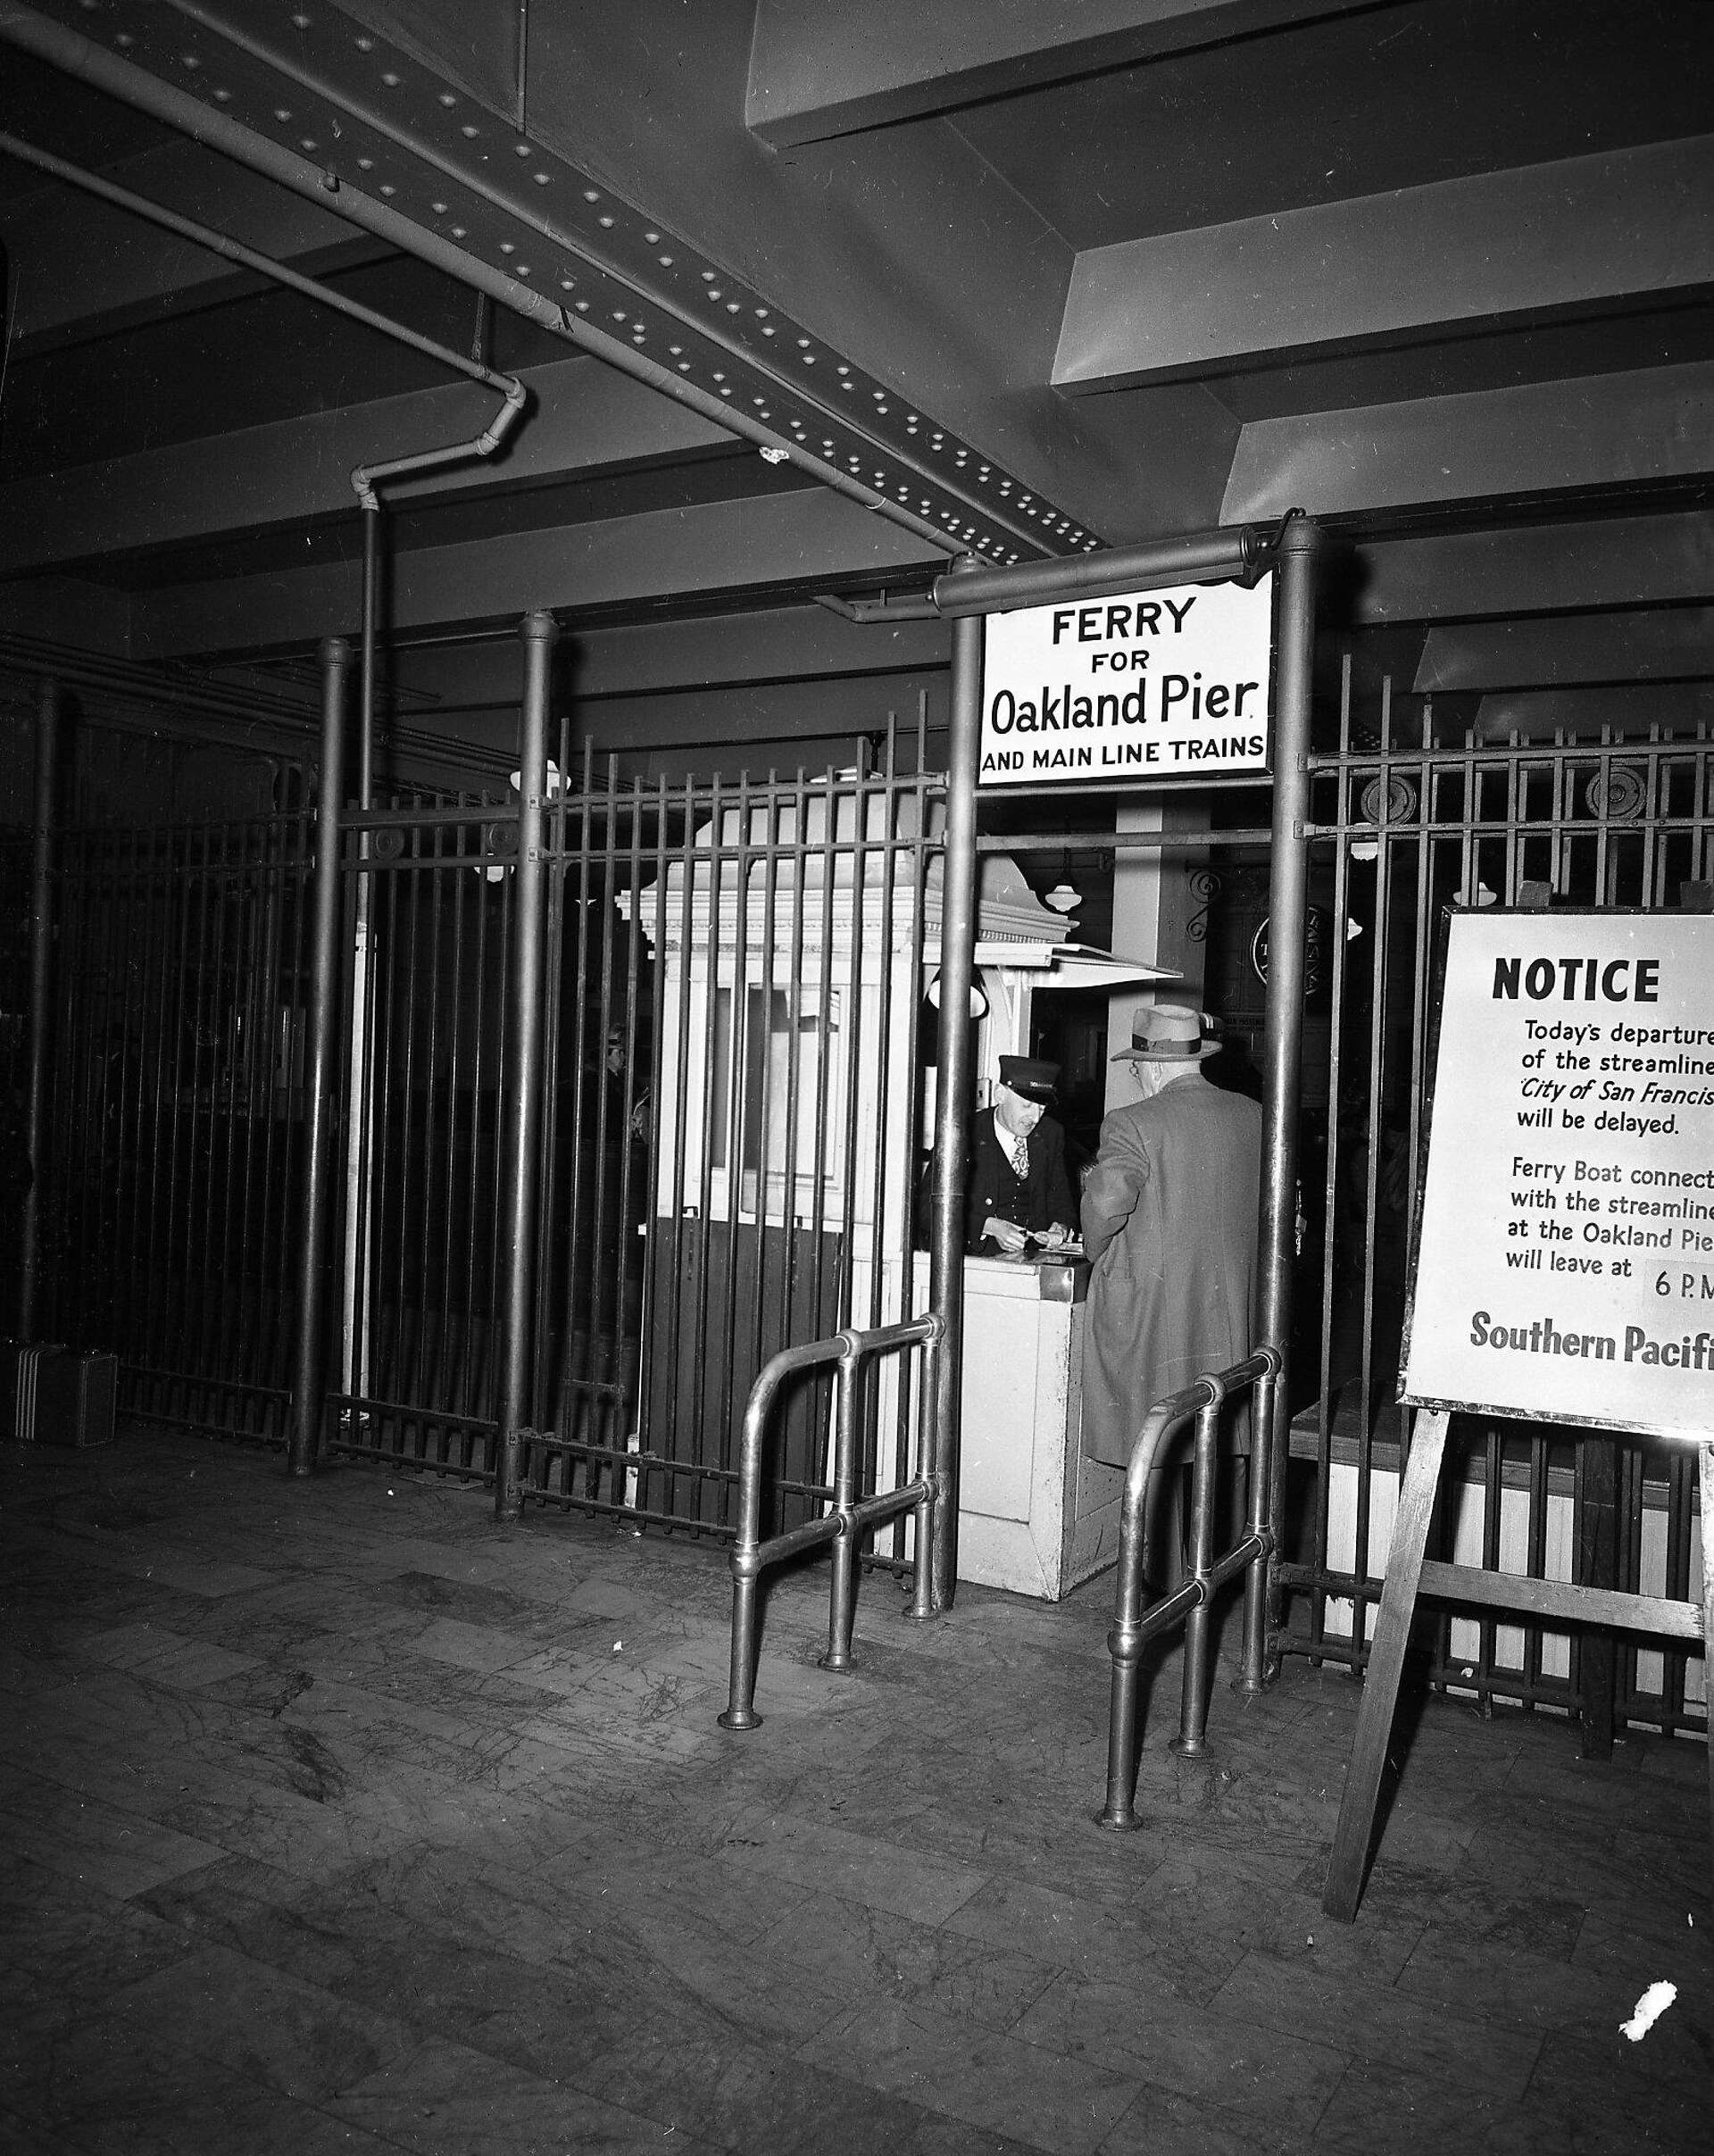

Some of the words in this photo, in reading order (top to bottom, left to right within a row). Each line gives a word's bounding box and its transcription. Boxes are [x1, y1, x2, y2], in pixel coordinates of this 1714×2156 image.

[1053, 596, 1197, 645] FERRY
[1092, 650, 1150, 673] FOR
[991, 678, 1146, 734] Oakland
[1161, 671, 1259, 722] Pier
[982, 752, 1024, 771] AND
[1033, 747, 1092, 768] MAIN
[1102, 743, 1160, 765] LINE
[1168, 736, 1264, 760] TRAINS
[1493, 958, 1660, 1002] NOTICE
[1525, 1020, 1601, 1045] Today's
[1610, 1022, 1714, 1046] departure
[1522, 1048, 1546, 1069] of
[1555, 1050, 1591, 1070] the
[1569, 1078, 1596, 1099] of
[1598, 1080, 1635, 1102] San
[1640, 1082, 1714, 1105] Francis
[1518, 1108, 1552, 1128] will
[1562, 1109, 1585, 1128] be
[1594, 1111, 1679, 1137] delayed.
[1513, 1156, 1566, 1184] Ferry
[1575, 1161, 1622, 1183] Boat
[1630, 1170, 1714, 1189] connect
[1511, 1188, 1557, 1209] with
[1566, 1191, 1600, 1211] the
[1508, 1220, 1528, 1237] at
[1539, 1220, 1573, 1240] the
[1583, 1222, 1672, 1248] Oakland
[1682, 1228, 1714, 1252] Pie
[1506, 1249, 1542, 1269] will
[1550, 1251, 1602, 1274] leave
[1611, 1259, 1632, 1278] at
[1655, 1270, 1671, 1296] 6
[1470, 1311, 1615, 1361] Southern
[1624, 1325, 1714, 1370] Pacifi
